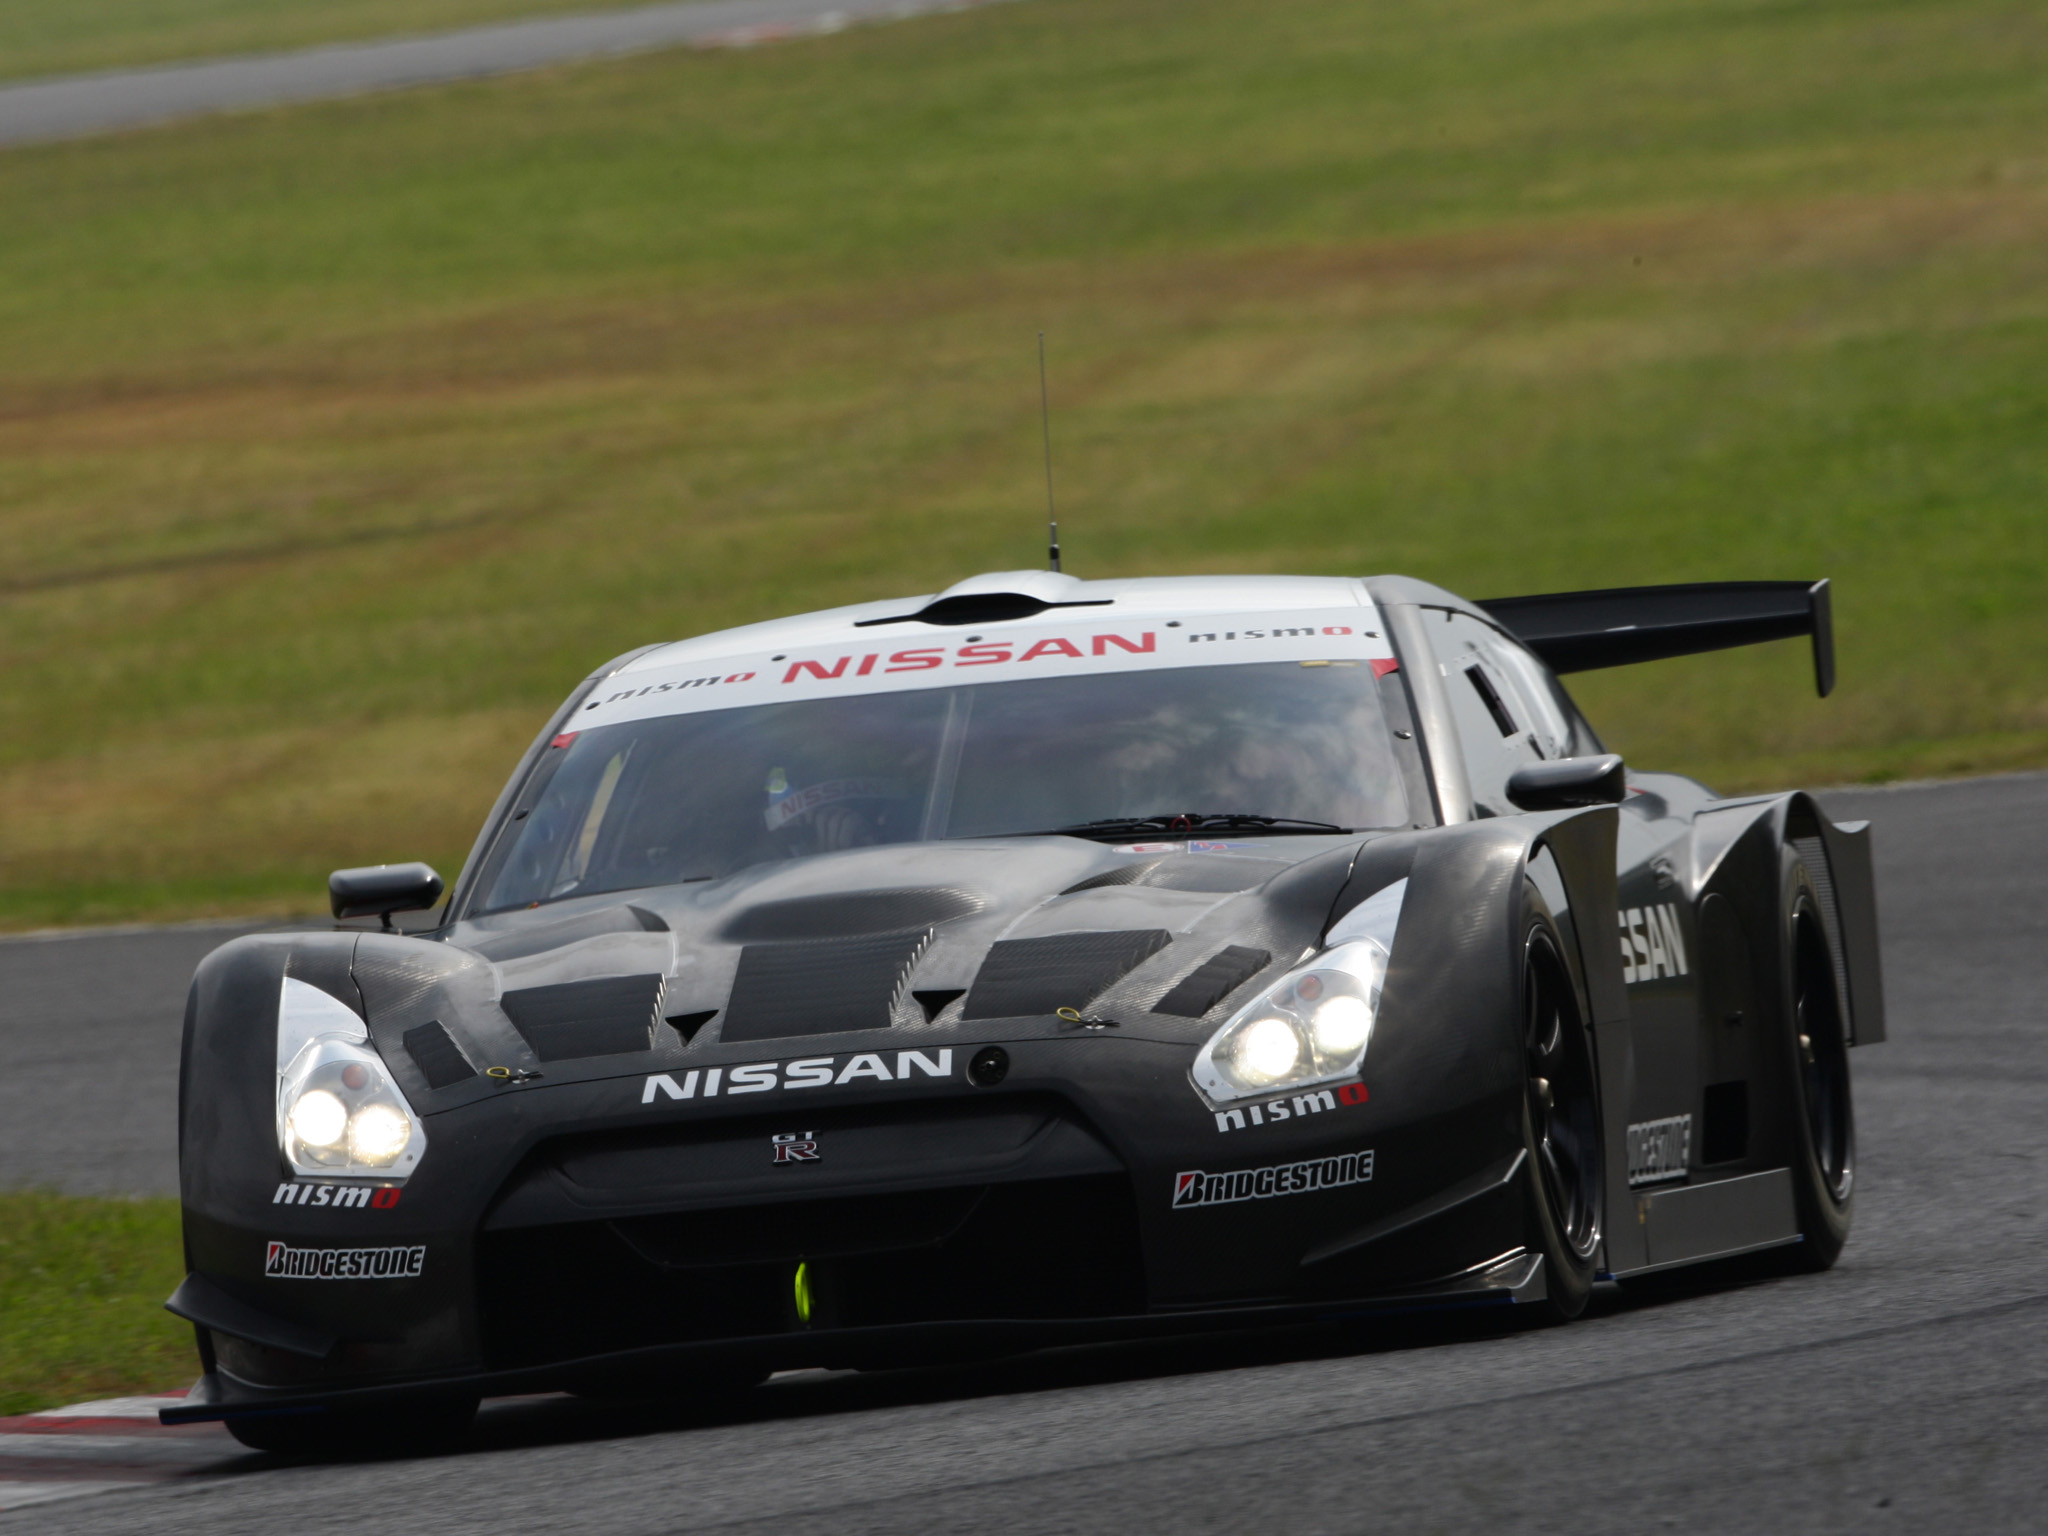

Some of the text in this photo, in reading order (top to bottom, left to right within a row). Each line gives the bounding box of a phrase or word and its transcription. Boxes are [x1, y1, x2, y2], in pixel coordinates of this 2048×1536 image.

[1188, 626, 1353, 643] nismo
[781, 632, 1157, 684] NISSAN
[606, 672, 756, 703] nismo
[641, 1049, 953, 1104] NISSAN
[1214, 1082, 1369, 1133] nismo
[272, 1183, 402, 1209] nismo
[1172, 1149, 1375, 1209] BRIDGESTONE
[265, 1241, 426, 1280] BRIDGESTONE
